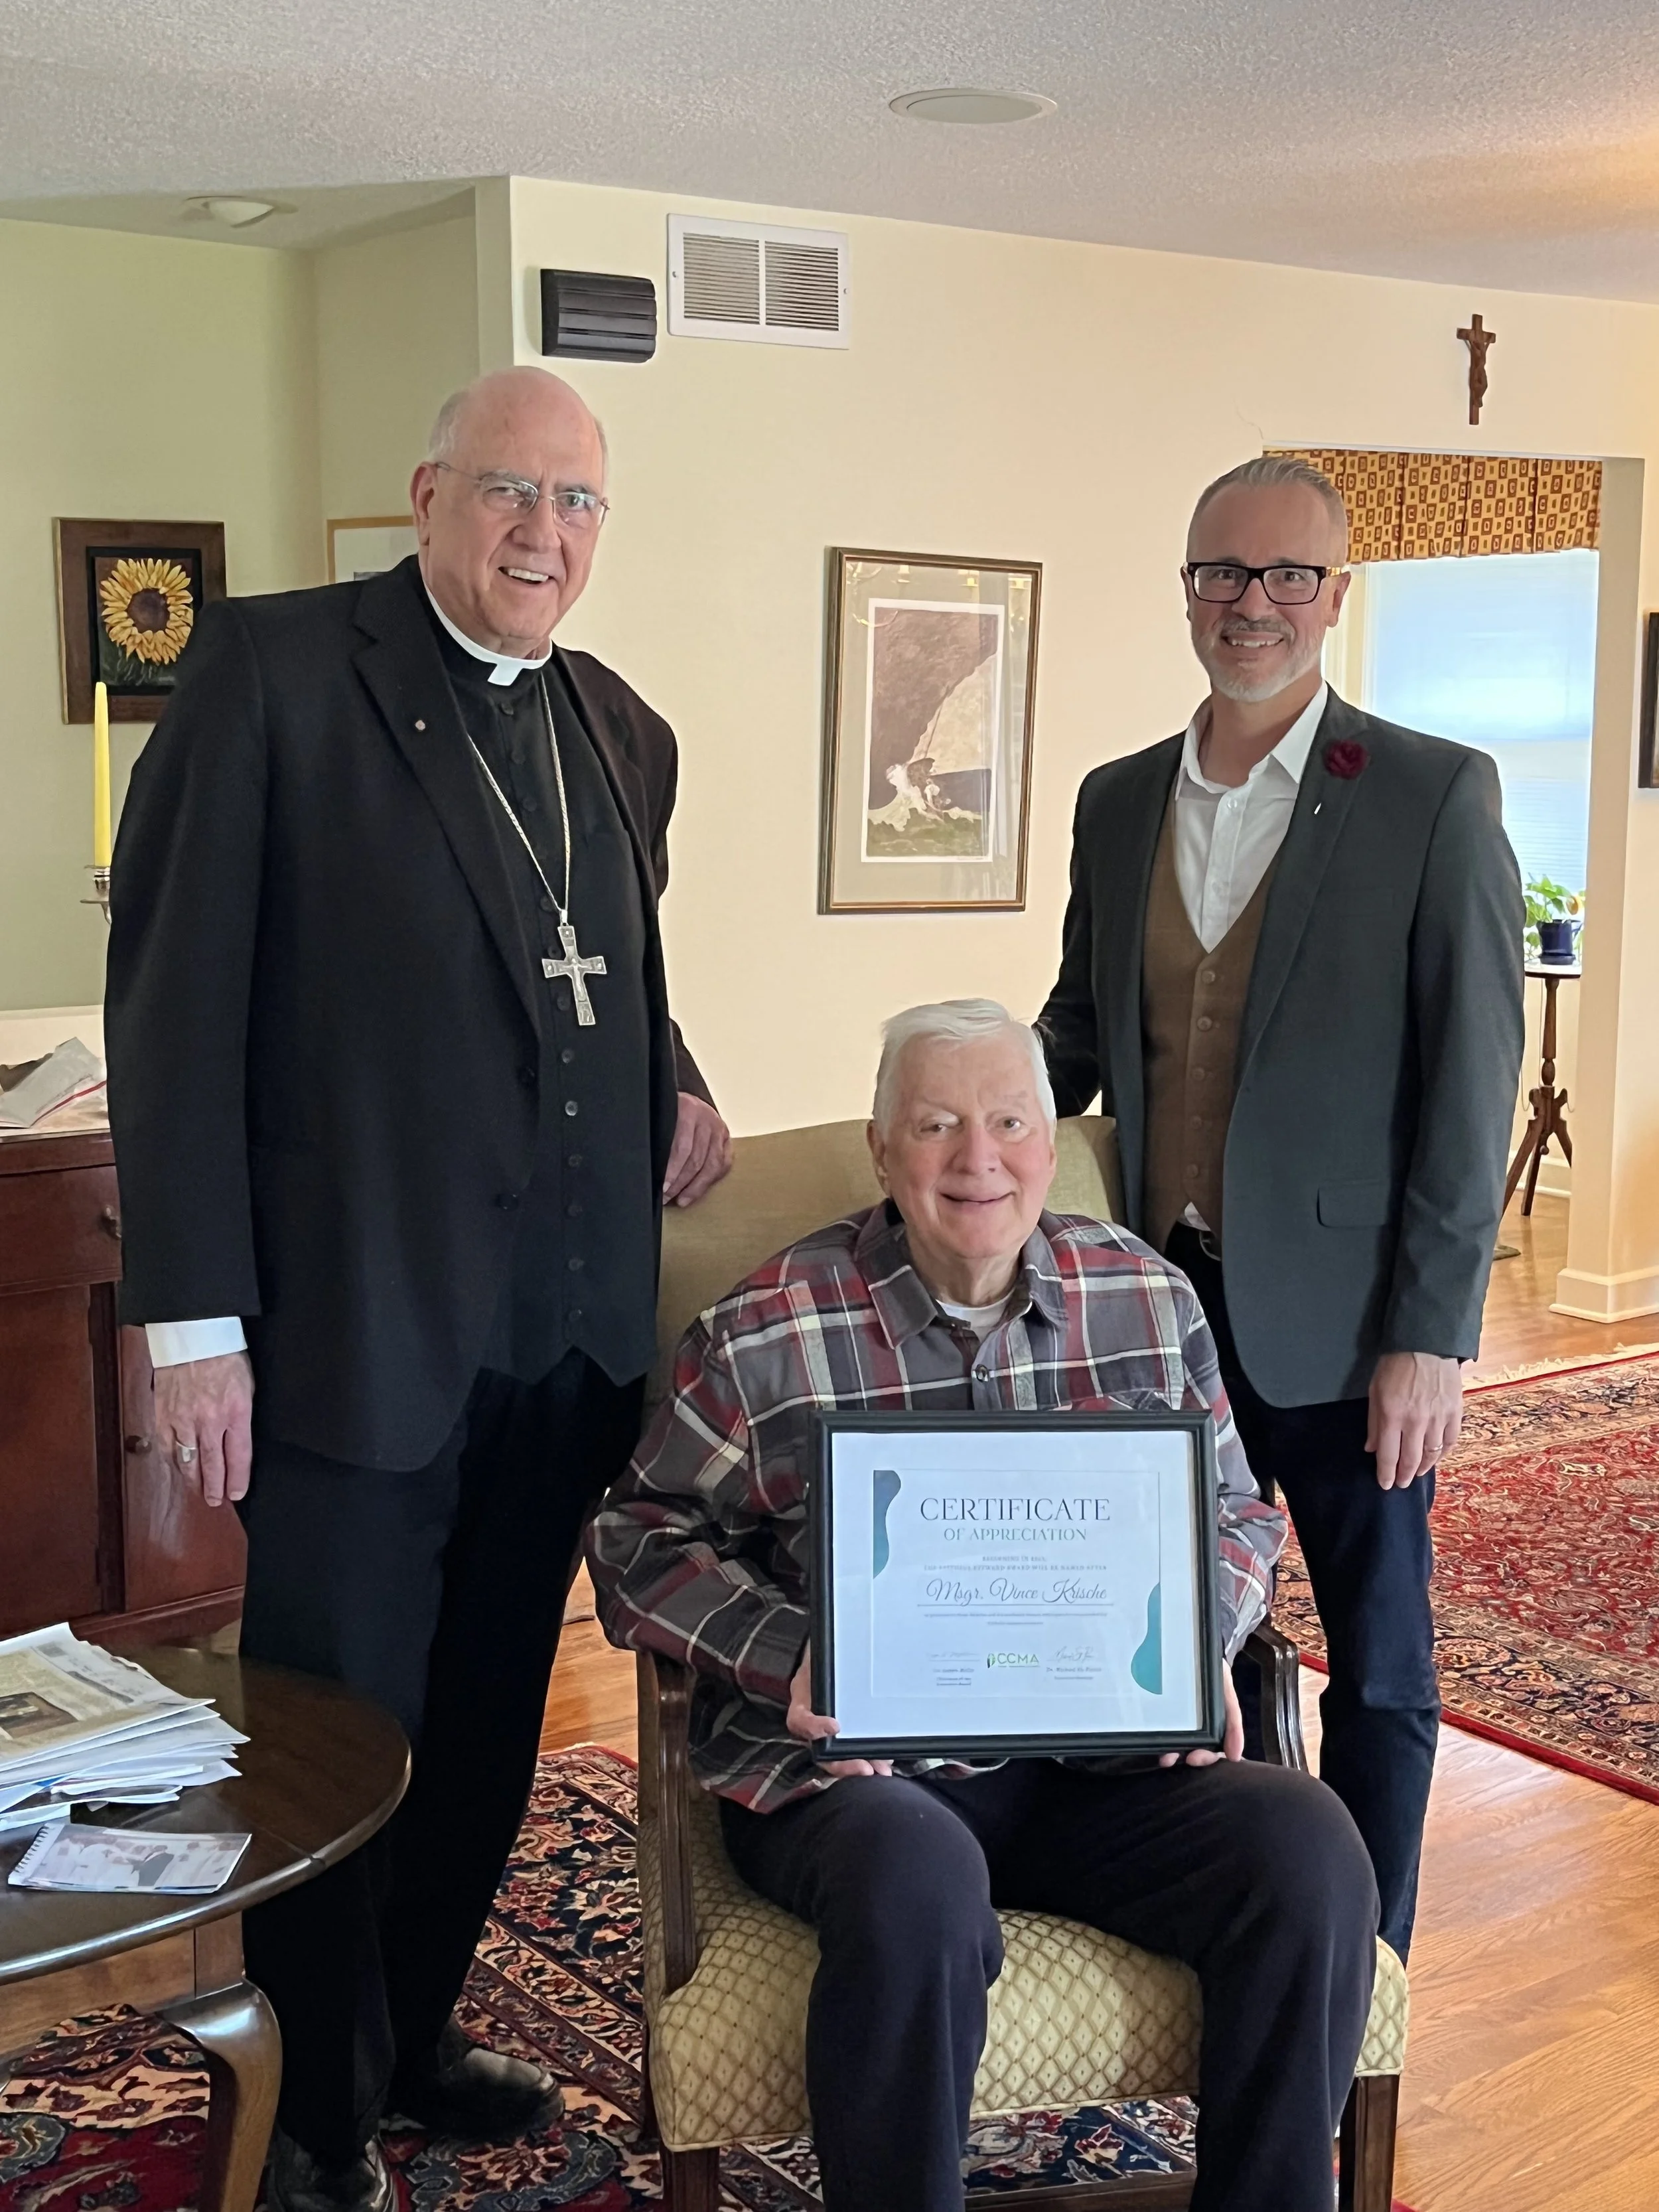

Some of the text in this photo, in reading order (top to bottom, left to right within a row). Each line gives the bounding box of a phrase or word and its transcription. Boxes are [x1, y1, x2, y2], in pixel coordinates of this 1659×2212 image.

[920, 1497, 1110, 1521] CERTIFICATE
[944, 1528, 1087, 1541] OF APPRECIATION
[926, 1578, 983, 1607] Msgr.
[989, 1578, 1039, 1601] Vince
[997, 1653, 1039, 1664] CCMA
